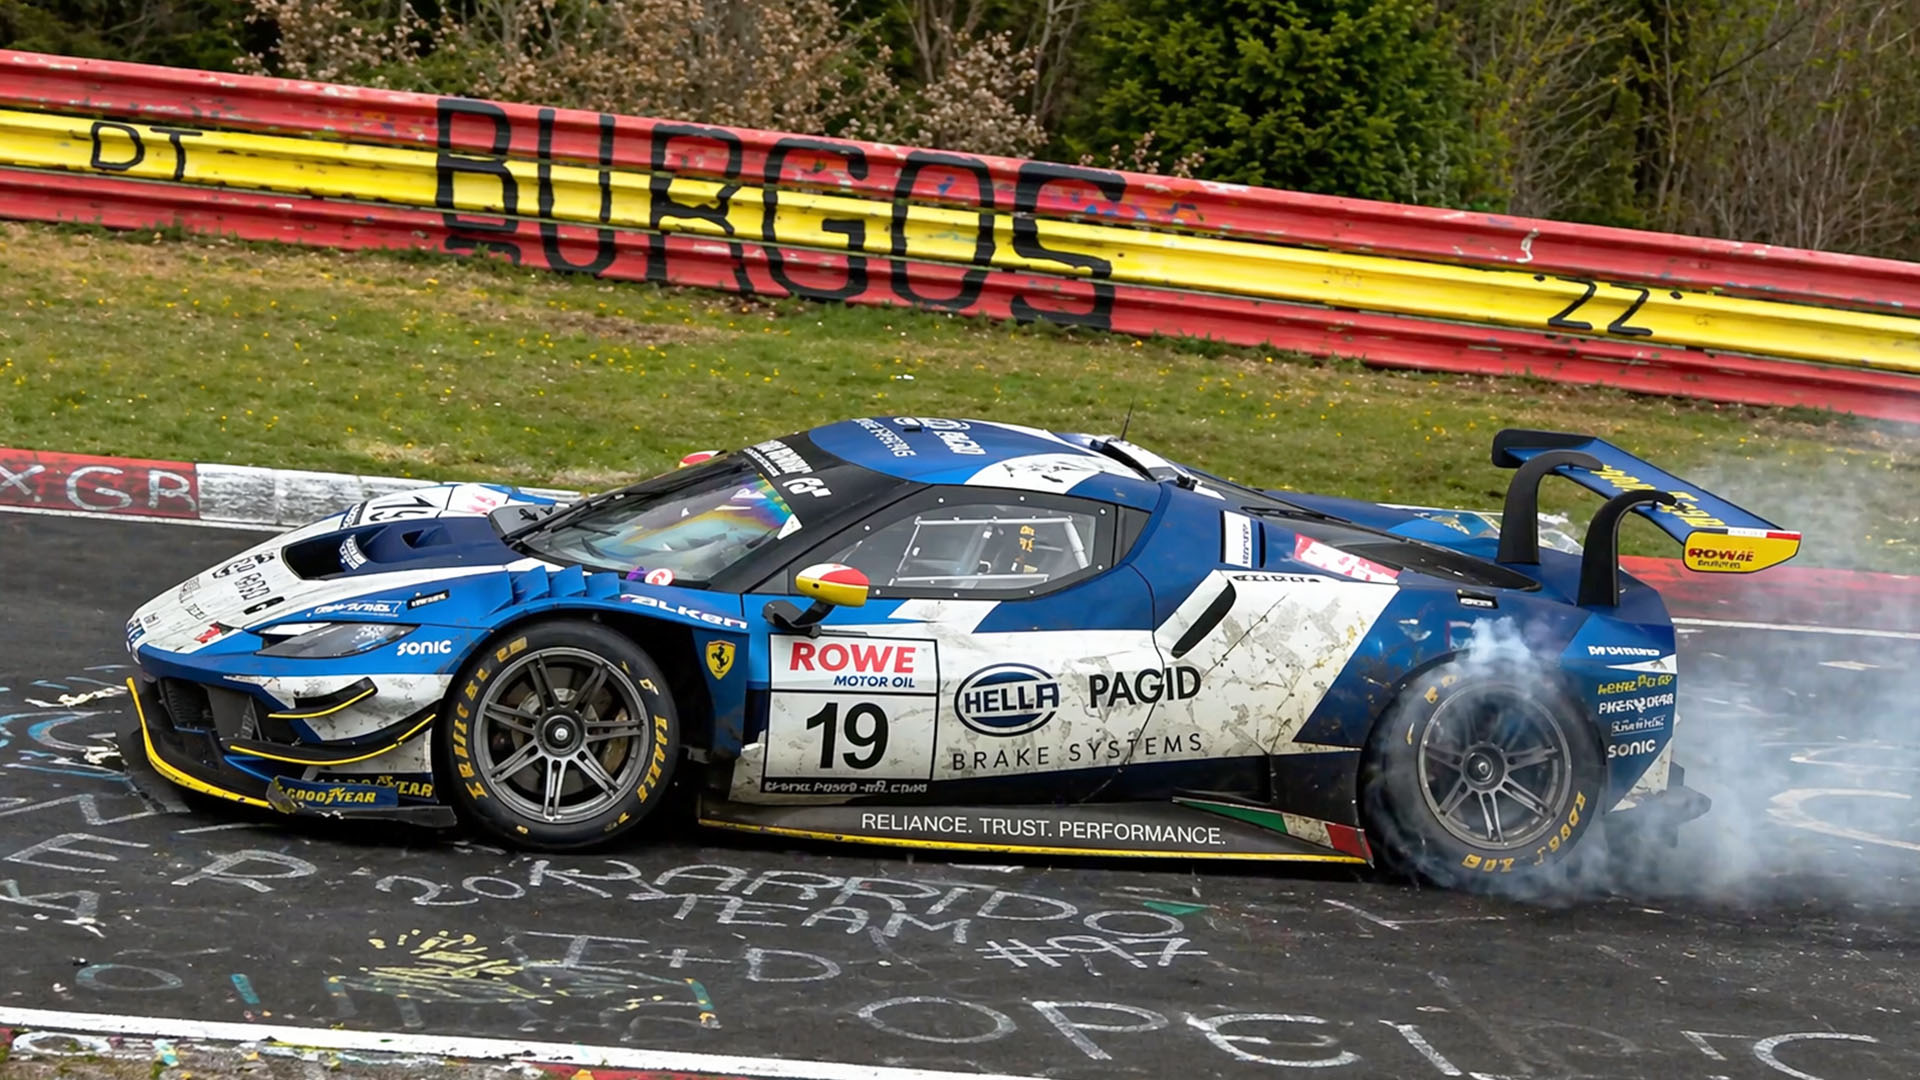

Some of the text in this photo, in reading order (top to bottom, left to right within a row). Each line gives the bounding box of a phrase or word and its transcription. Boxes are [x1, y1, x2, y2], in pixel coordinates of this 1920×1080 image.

[436, 98, 1127, 329] BURGOS
[789, 641, 916, 673] ROWE
[833, 675, 916, 689] MOTOR OIL
[964, 682, 1060, 714] HELLA
[1089, 665, 1201, 710] PAGID
[804, 701, 889, 770] 19
[952, 732, 1203, 772] BRAKE SYSTEMS
[861, 813, 1226, 846] RELIANCE. TRUST. PERFORMANCE.
